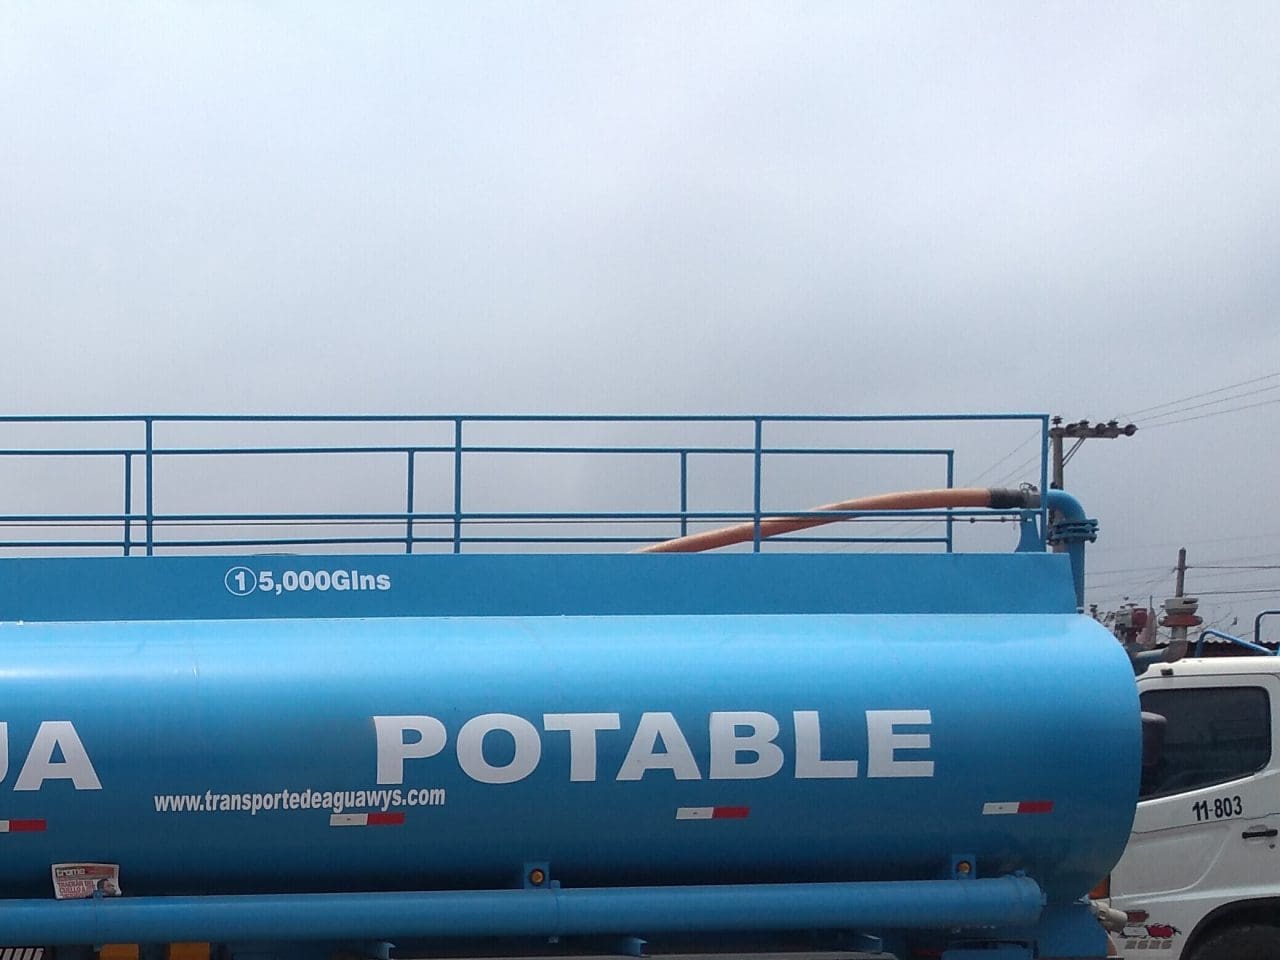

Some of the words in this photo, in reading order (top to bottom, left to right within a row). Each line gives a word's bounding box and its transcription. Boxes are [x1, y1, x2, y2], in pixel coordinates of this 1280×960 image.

[372, 709, 935, 785] POTABLE
[154, 788, 446, 815] www.transportedeaguawys.com
[1192, 795, 1243, 821] 11-803
